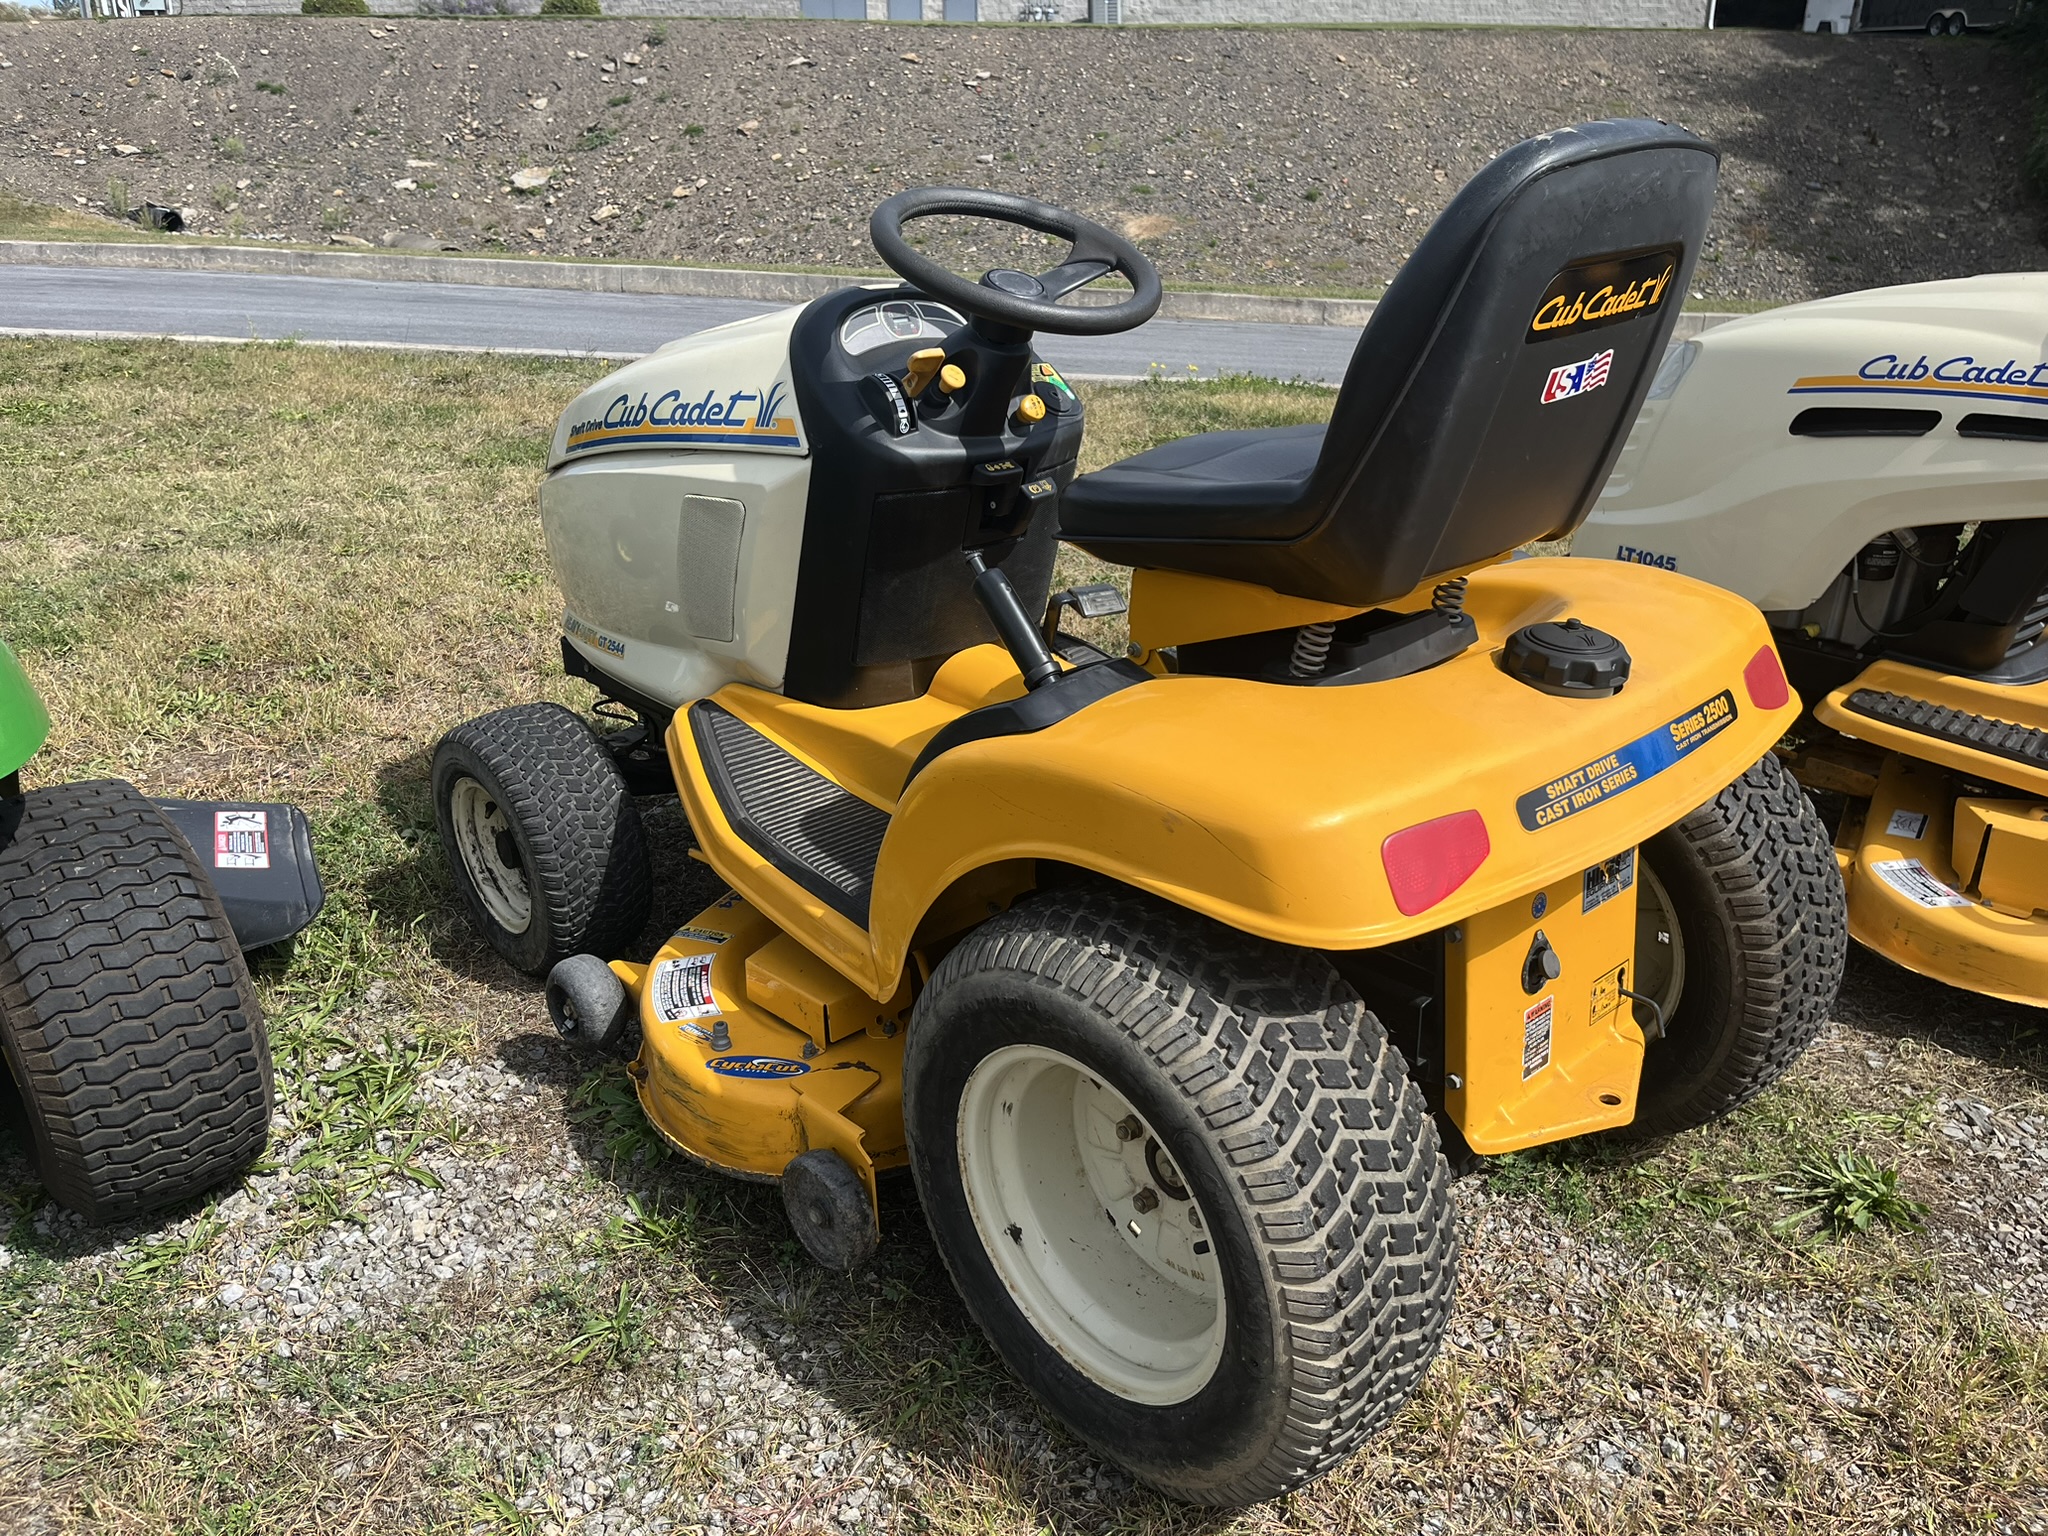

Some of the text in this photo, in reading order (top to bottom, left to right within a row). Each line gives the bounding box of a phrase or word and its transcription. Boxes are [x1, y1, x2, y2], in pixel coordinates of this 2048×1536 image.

[1532, 277, 1657, 331] Cub Cadet
[1543, 363, 1587, 402] USA
[1858, 354, 2048, 387] Cub Cadet
[570, 389, 758, 437] Shaft Drive Cub Cadet
[1670, 695, 1729, 742] SERIES 2500
[1675, 713, 1733, 751] CAST IRON TRANSMISSION
[1536, 765, 1638, 826] CAST IRON SERIES
[1545, 754, 1620, 800] SHAFT DRIVE
[709, 1059, 801, 1073] CycloCut
